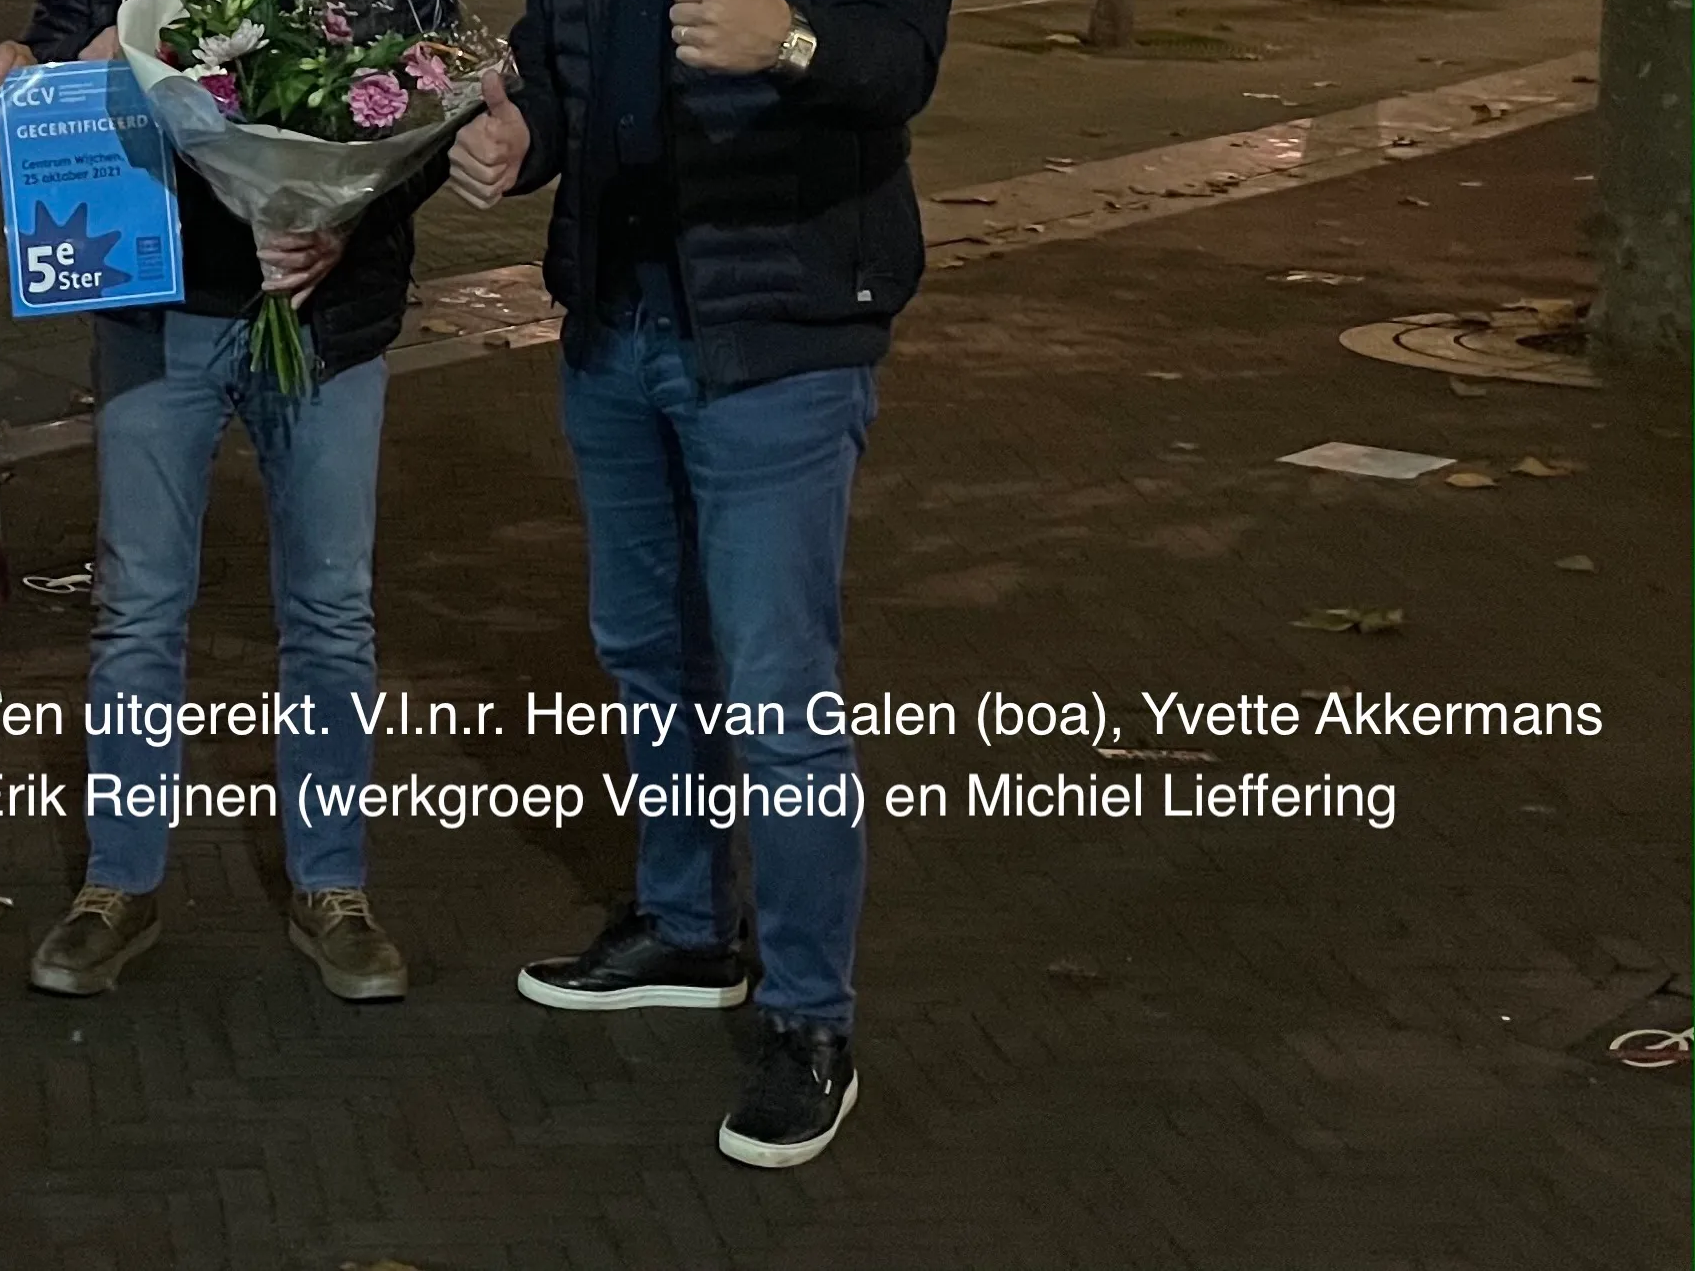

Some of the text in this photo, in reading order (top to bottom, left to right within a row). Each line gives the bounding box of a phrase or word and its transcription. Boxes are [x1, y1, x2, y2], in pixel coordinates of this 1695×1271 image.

[12, 86, 55, 107] CCV
[17, 115, 148, 139] GECERTIFICEERD
[22, 158, 72, 170] Centrum
[24, 167, 121, 185] 25 oktober 2021
[59, 271, 102, 290] Ster
